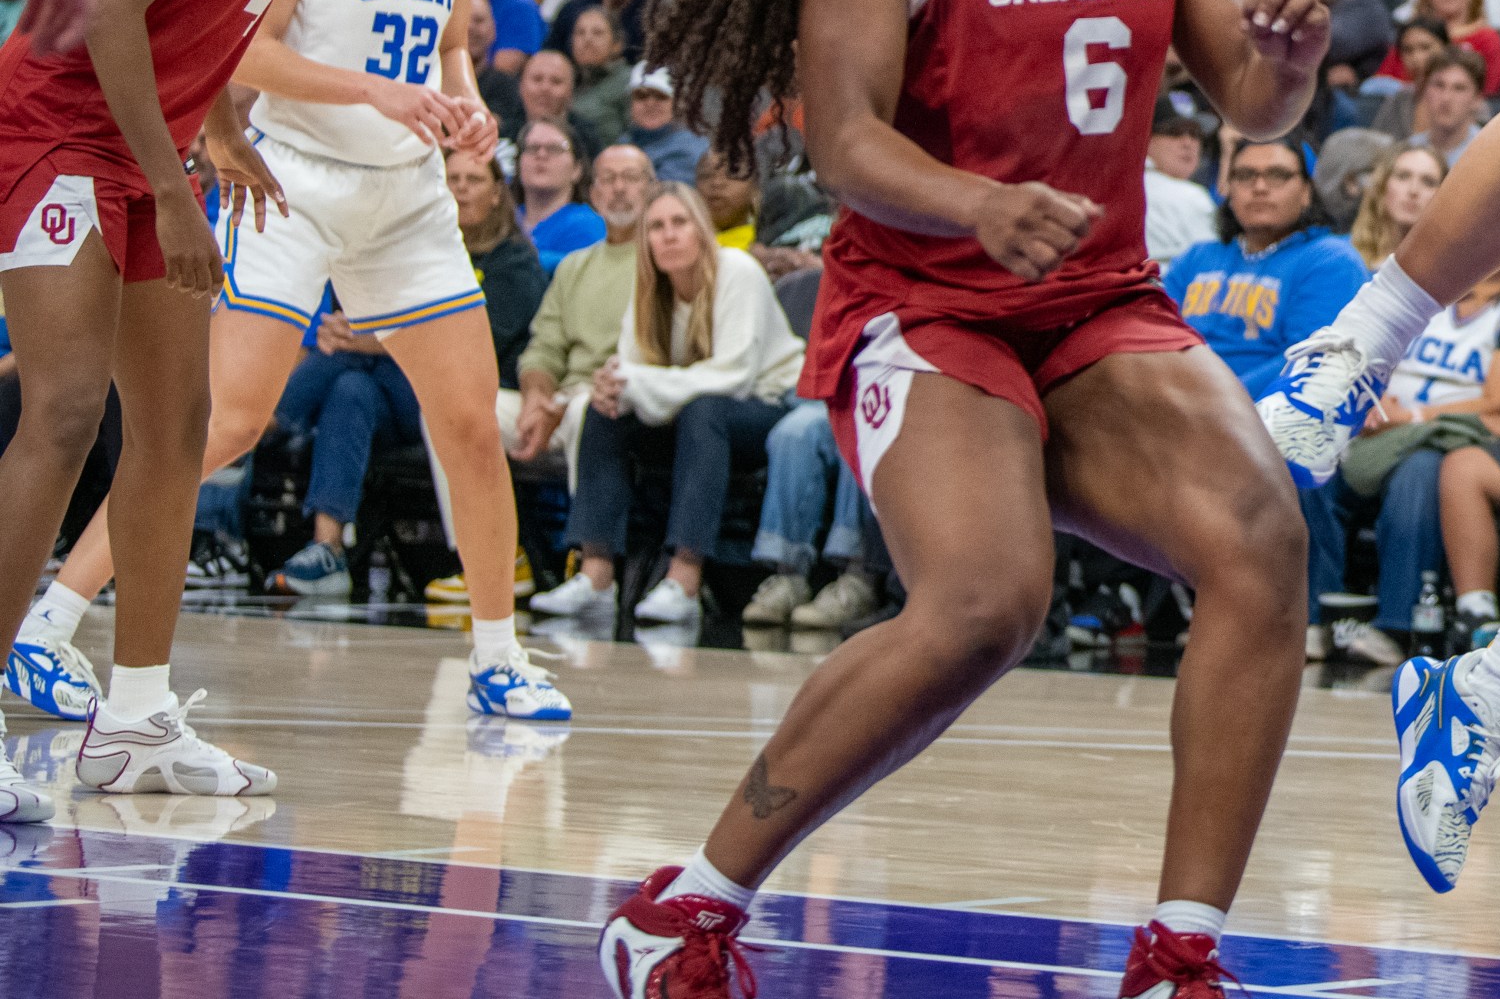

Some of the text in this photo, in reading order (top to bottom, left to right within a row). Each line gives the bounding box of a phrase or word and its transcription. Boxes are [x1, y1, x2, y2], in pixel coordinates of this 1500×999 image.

[365, 11, 439, 85] 32
[1063, 16, 1132, 135] 6
[41, 203, 75, 244] OU
[1181, 281, 1278, 338] BRINS
